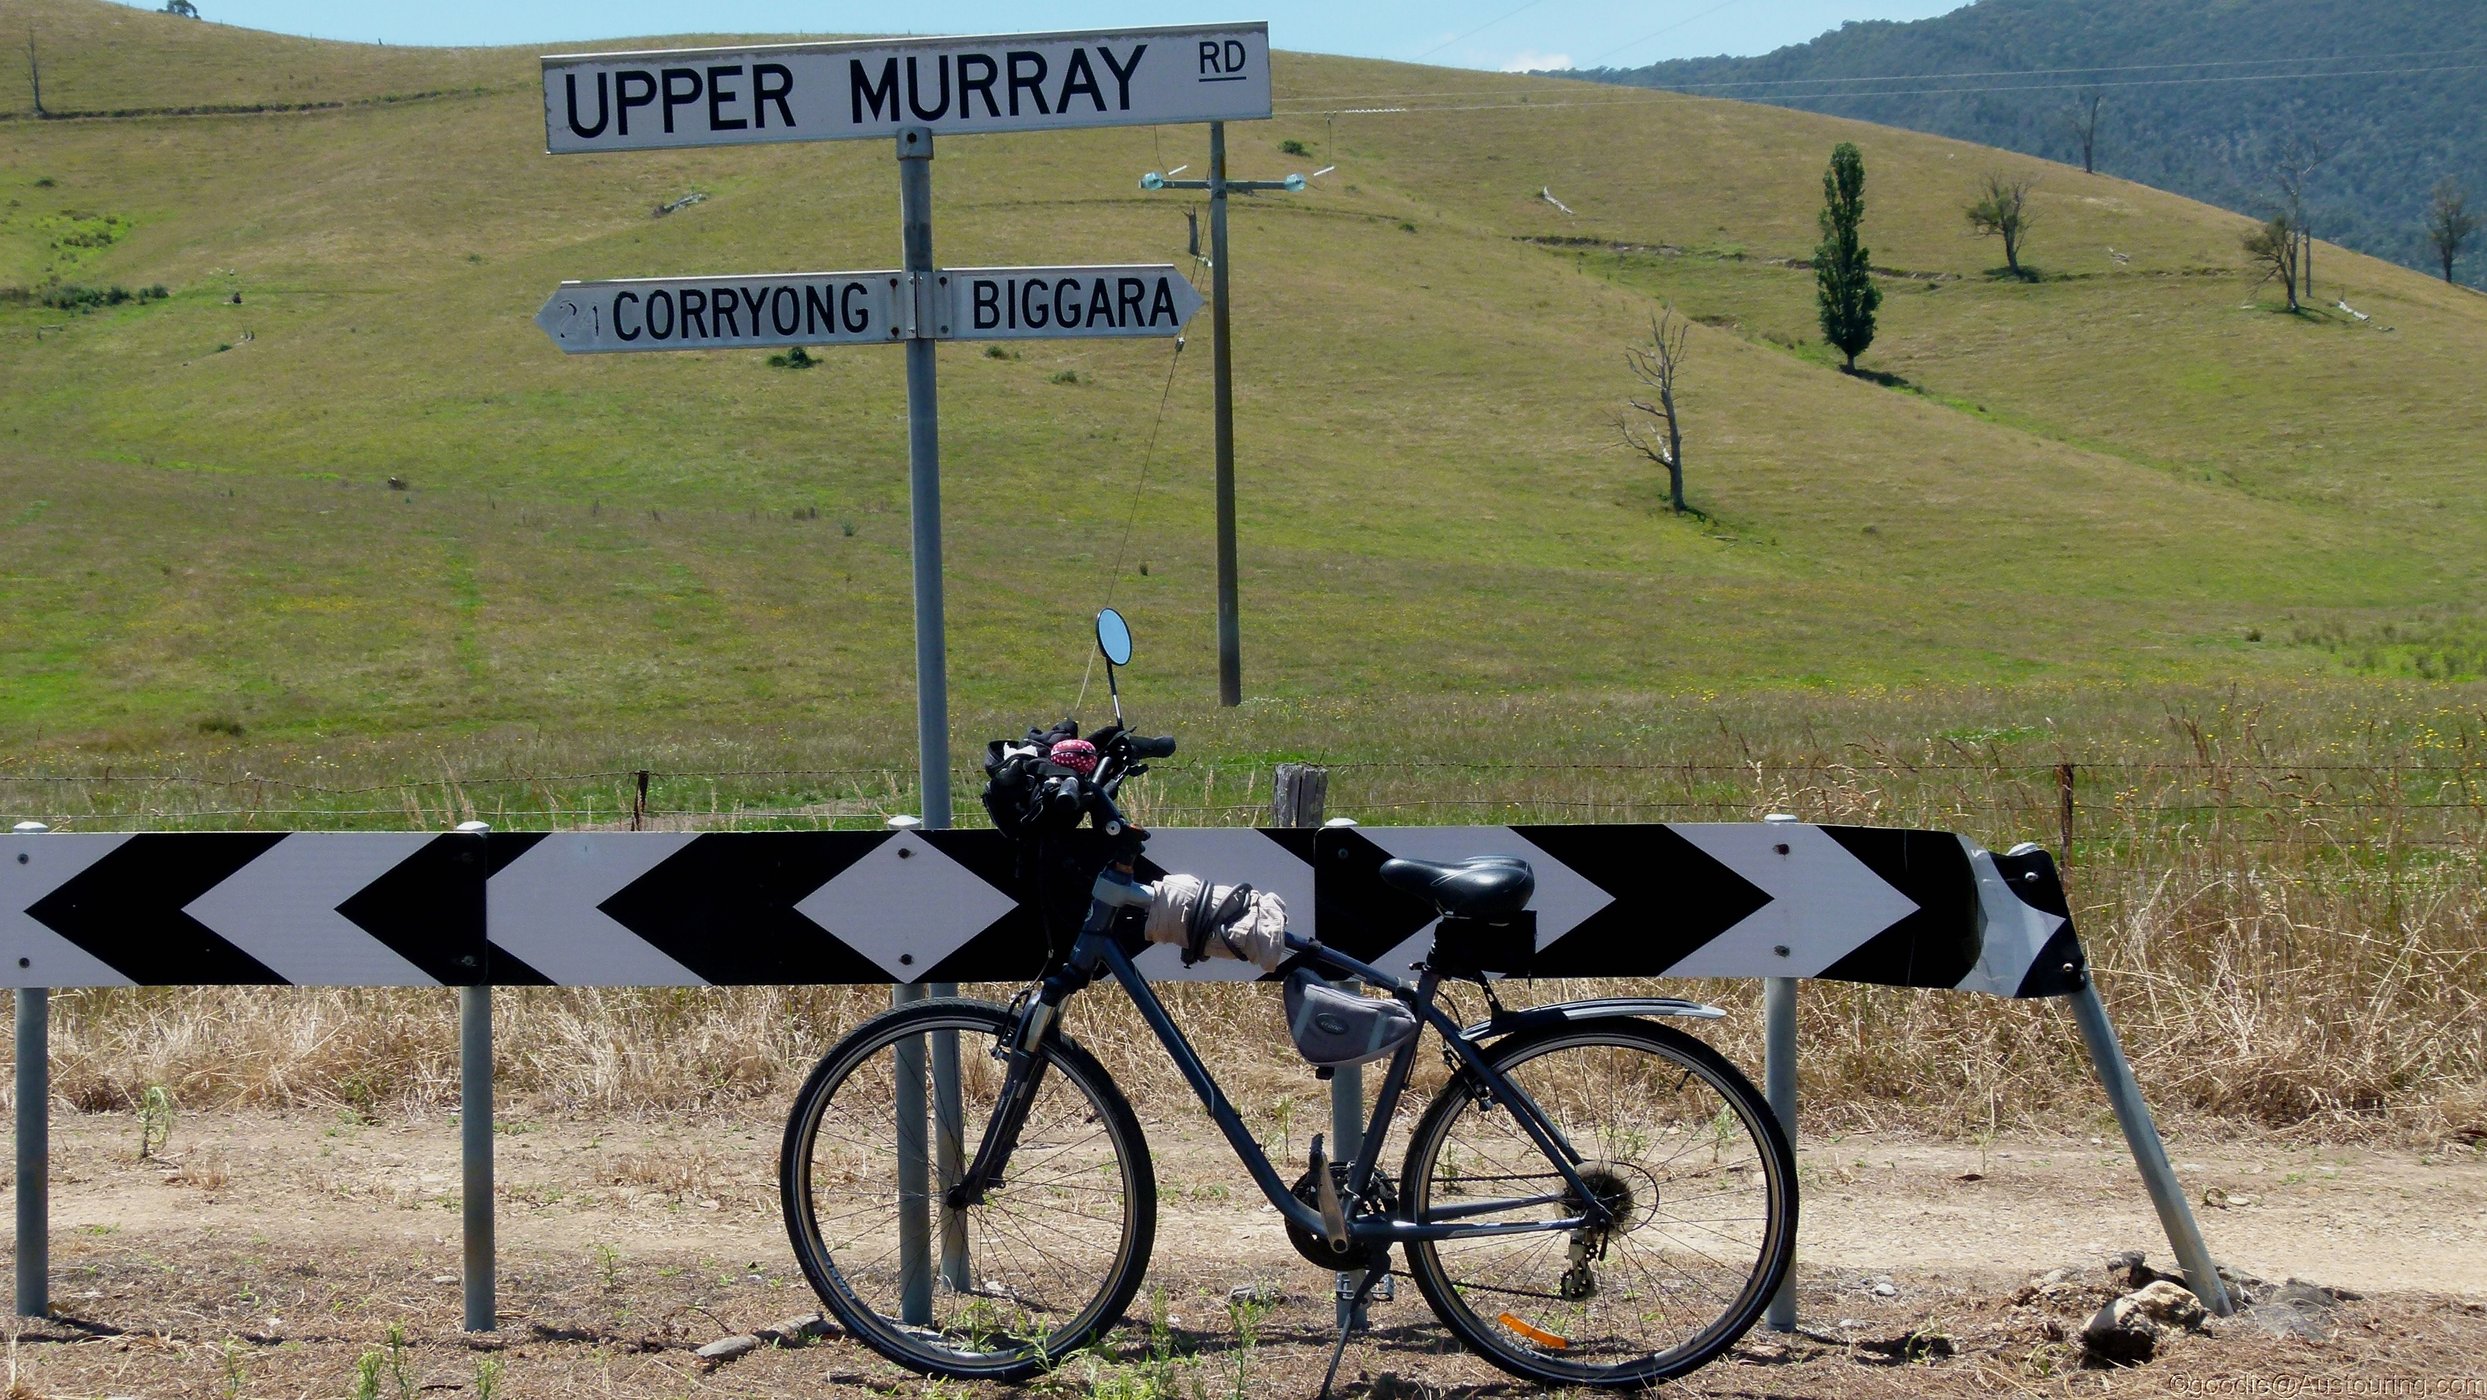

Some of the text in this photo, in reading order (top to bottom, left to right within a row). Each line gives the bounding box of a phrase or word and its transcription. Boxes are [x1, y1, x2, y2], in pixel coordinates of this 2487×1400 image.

[565, 40, 1247, 139] UPPER MURRAY RD
[612, 281, 870, 342] CORRYONG
[973, 277, 1180, 330] BIGGARA
